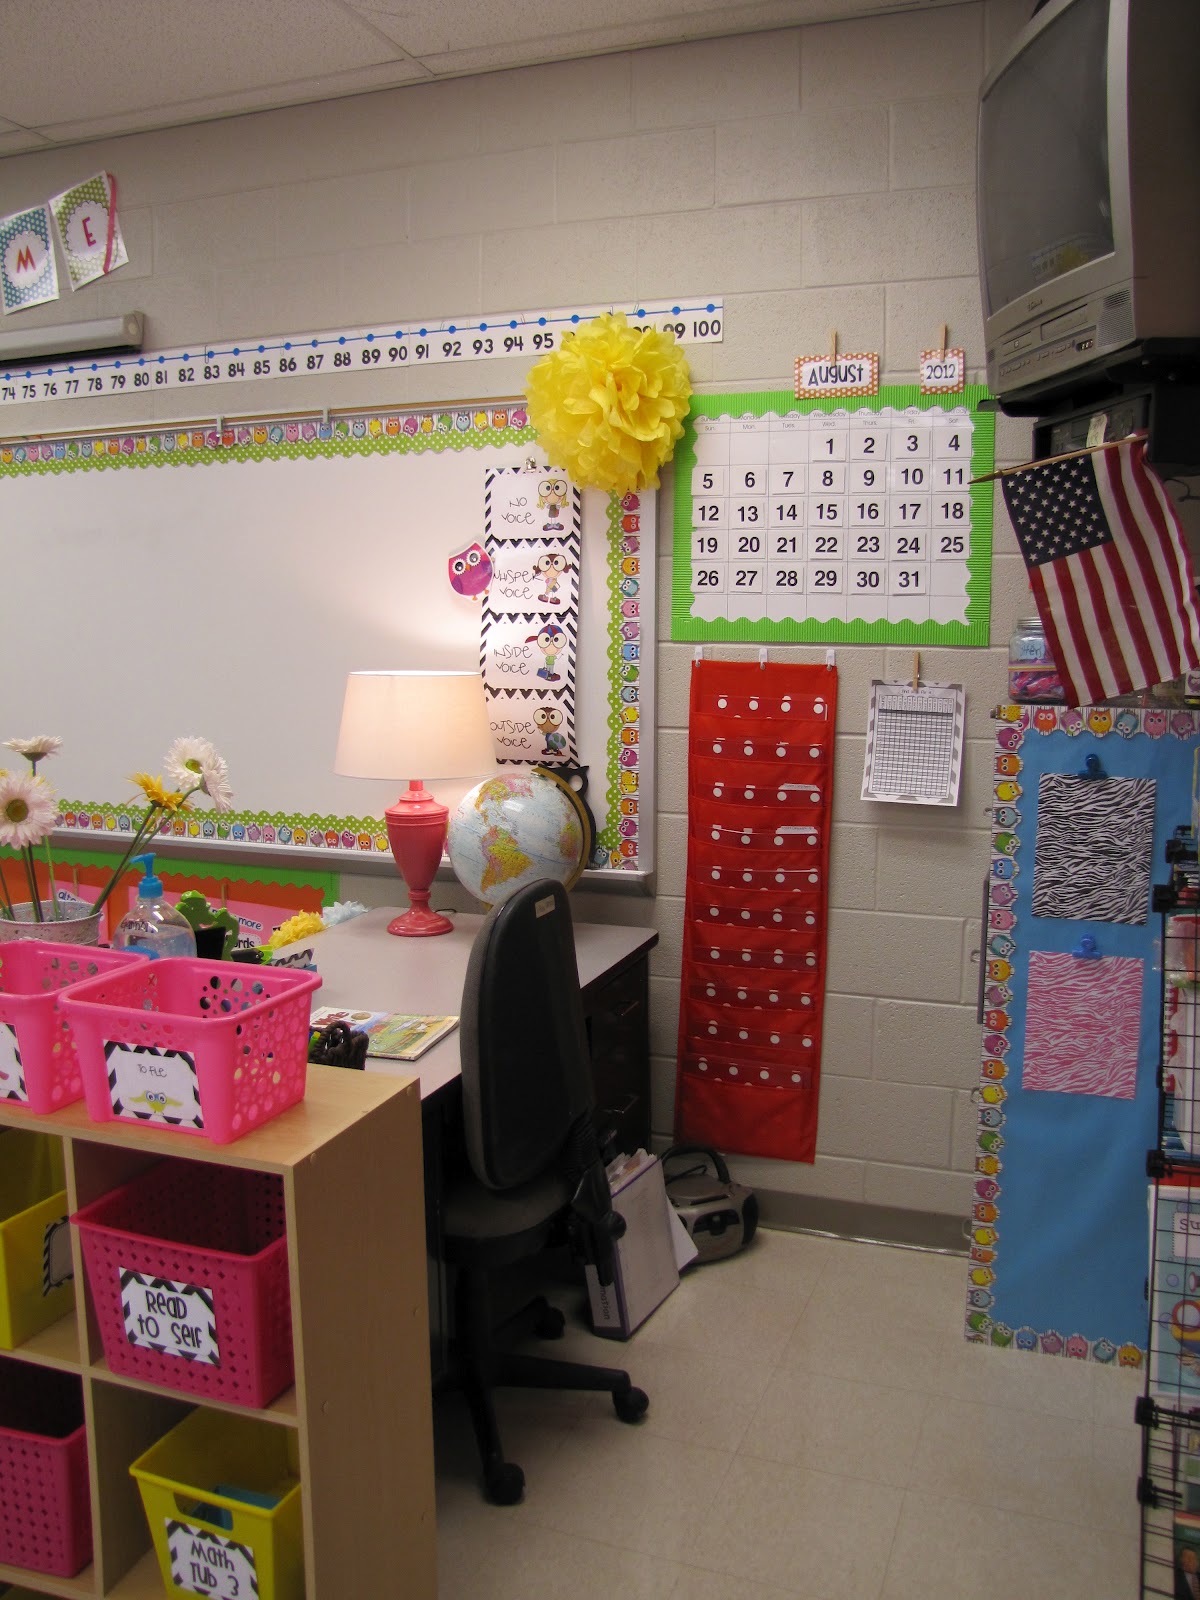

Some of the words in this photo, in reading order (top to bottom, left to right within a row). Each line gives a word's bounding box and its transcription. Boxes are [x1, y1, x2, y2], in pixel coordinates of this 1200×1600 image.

[16, 245, 36, 274] M
[82, 216, 97, 247] E
[2, 387, 15, 400] 74
[22, 385, 36, 398] 75
[44, 383, 57, 396] 76
[66, 380, 79, 394] 77
[88, 378, 102, 391] 78
[111, 375, 125, 389] 79
[134, 373, 149, 386] 80
[156, 371, 167, 384] 81
[179, 368, 194, 382] 82
[204, 365, 220, 379] 83
[228, 363, 245, 377] 84
[254, 360, 270, 375] 85
[279, 358, 296, 372] 86
[307, 355, 324, 369] 87
[334, 352, 351, 367] 88
[362, 349, 380, 364] 89
[389, 346, 407, 361] 90
[416, 344, 428, 359] 91
[443, 342, 461, 356] 92
[473, 339, 493, 354] 93
[504, 336, 523, 352] 94
[533, 333, 553, 349] 95
[694, 320, 721, 337] 100
[808, 362, 863, 386] August
[927, 364, 955, 379] 2012
[826, 439, 833, 454] 1
[864, 438, 874, 453] 2
[907, 435, 918, 451] 3
[949, 435, 960, 451] 4
[703, 474, 713, 489] 5
[745, 472, 755, 487] 6
[783, 472, 793, 487] 7
[823, 471, 833, 486] 8
[864, 470, 874, 486] 9
[902, 469, 923, 484] 10
[944, 469, 962, 484] 11
[699, 506, 718, 520] 12
[738, 506, 758, 521] 13
[777, 505, 797, 520] 14
[817, 504, 837, 520] 15
[858, 503, 878, 519] 16
[899, 504, 921, 519] 17
[942, 503, 963, 519] 18
[698, 538, 717, 553] 19
[739, 537, 759, 552] 20
[777, 537, 795, 552] 21
[815, 537, 837, 552] 22
[857, 537, 879, 552] 23
[897, 538, 920, 553] 24
[941, 537, 963, 553] 25
[698, 571, 718, 586] 26
[736, 571, 757, 586] 27
[776, 571, 797, 586] 28
[815, 571, 837, 586] 29
[857, 572, 879, 587] 30
[899, 571, 918, 587] 31
[238, 917, 262, 930] more
[191, 1539, 235, 1572] Math
[227, 1574, 240, 1597] 3
